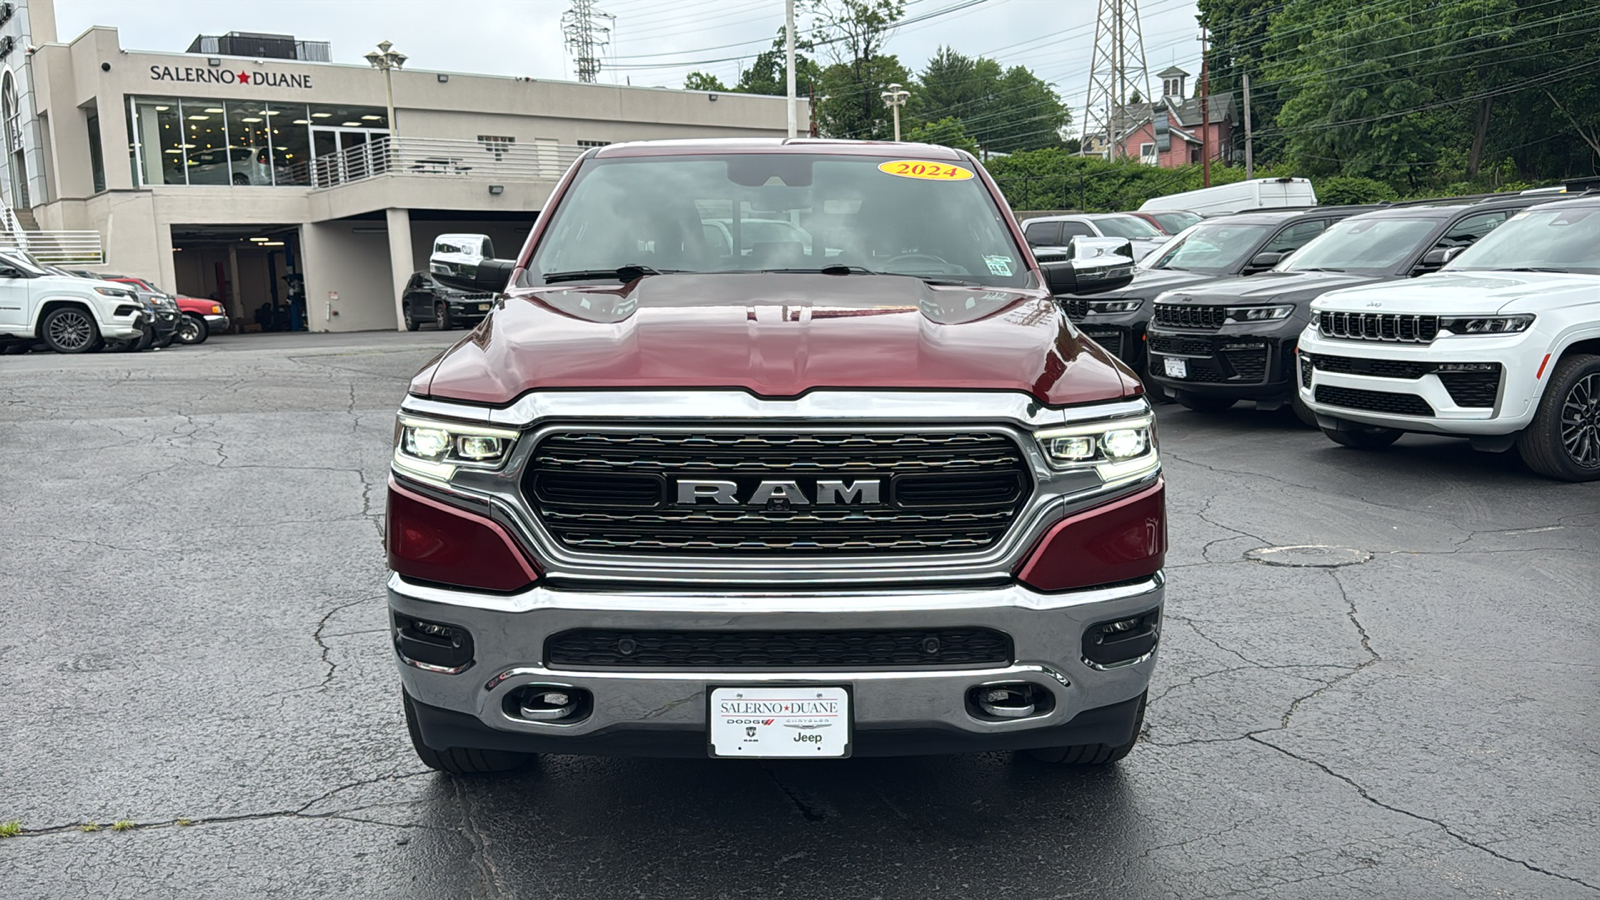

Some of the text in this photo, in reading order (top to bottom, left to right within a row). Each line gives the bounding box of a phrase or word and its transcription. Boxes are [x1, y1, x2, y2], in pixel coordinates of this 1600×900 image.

[150, 65, 313, 88] SALERNO DUANE
[896, 163, 958, 177] 2024
[676, 479, 881, 505] RAM
[720, 702, 838, 714] SALERNO DUANE
[793, 733, 822, 744] Jeep
